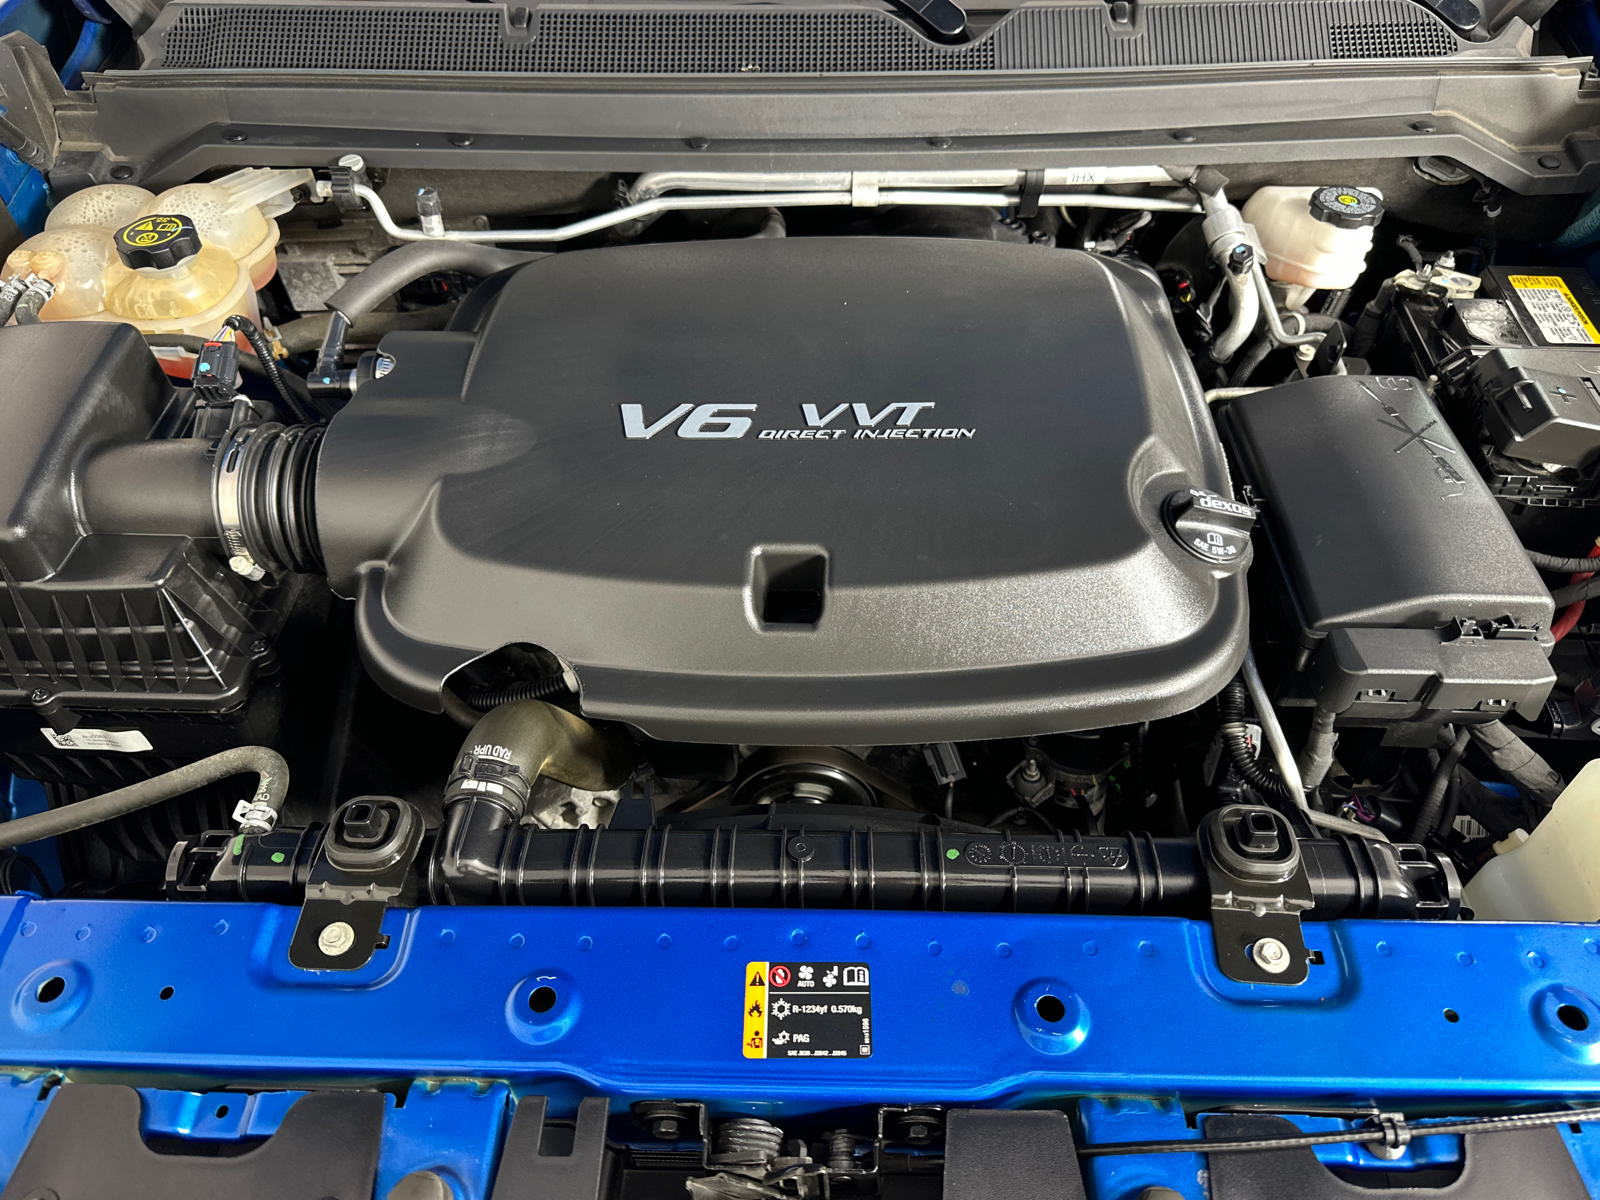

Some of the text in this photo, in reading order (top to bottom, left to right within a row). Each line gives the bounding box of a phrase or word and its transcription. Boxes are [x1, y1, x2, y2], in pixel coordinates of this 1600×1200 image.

[1072, 172, 1096, 183] IHX
[620, 402, 936, 439] V6 VVT
[758, 428, 976, 440] DIRECT INJECTION
[1200, 496, 1252, 516] dexos
[1193, 538, 1237, 556] SAE 5W-30
[473, 744, 512, 760] RAD UPR
[797, 980, 815, 988] AUTO
[792, 1005, 862, 1015] R-1234yf 0.570kg
[792, 1034, 810, 1043] PAG
